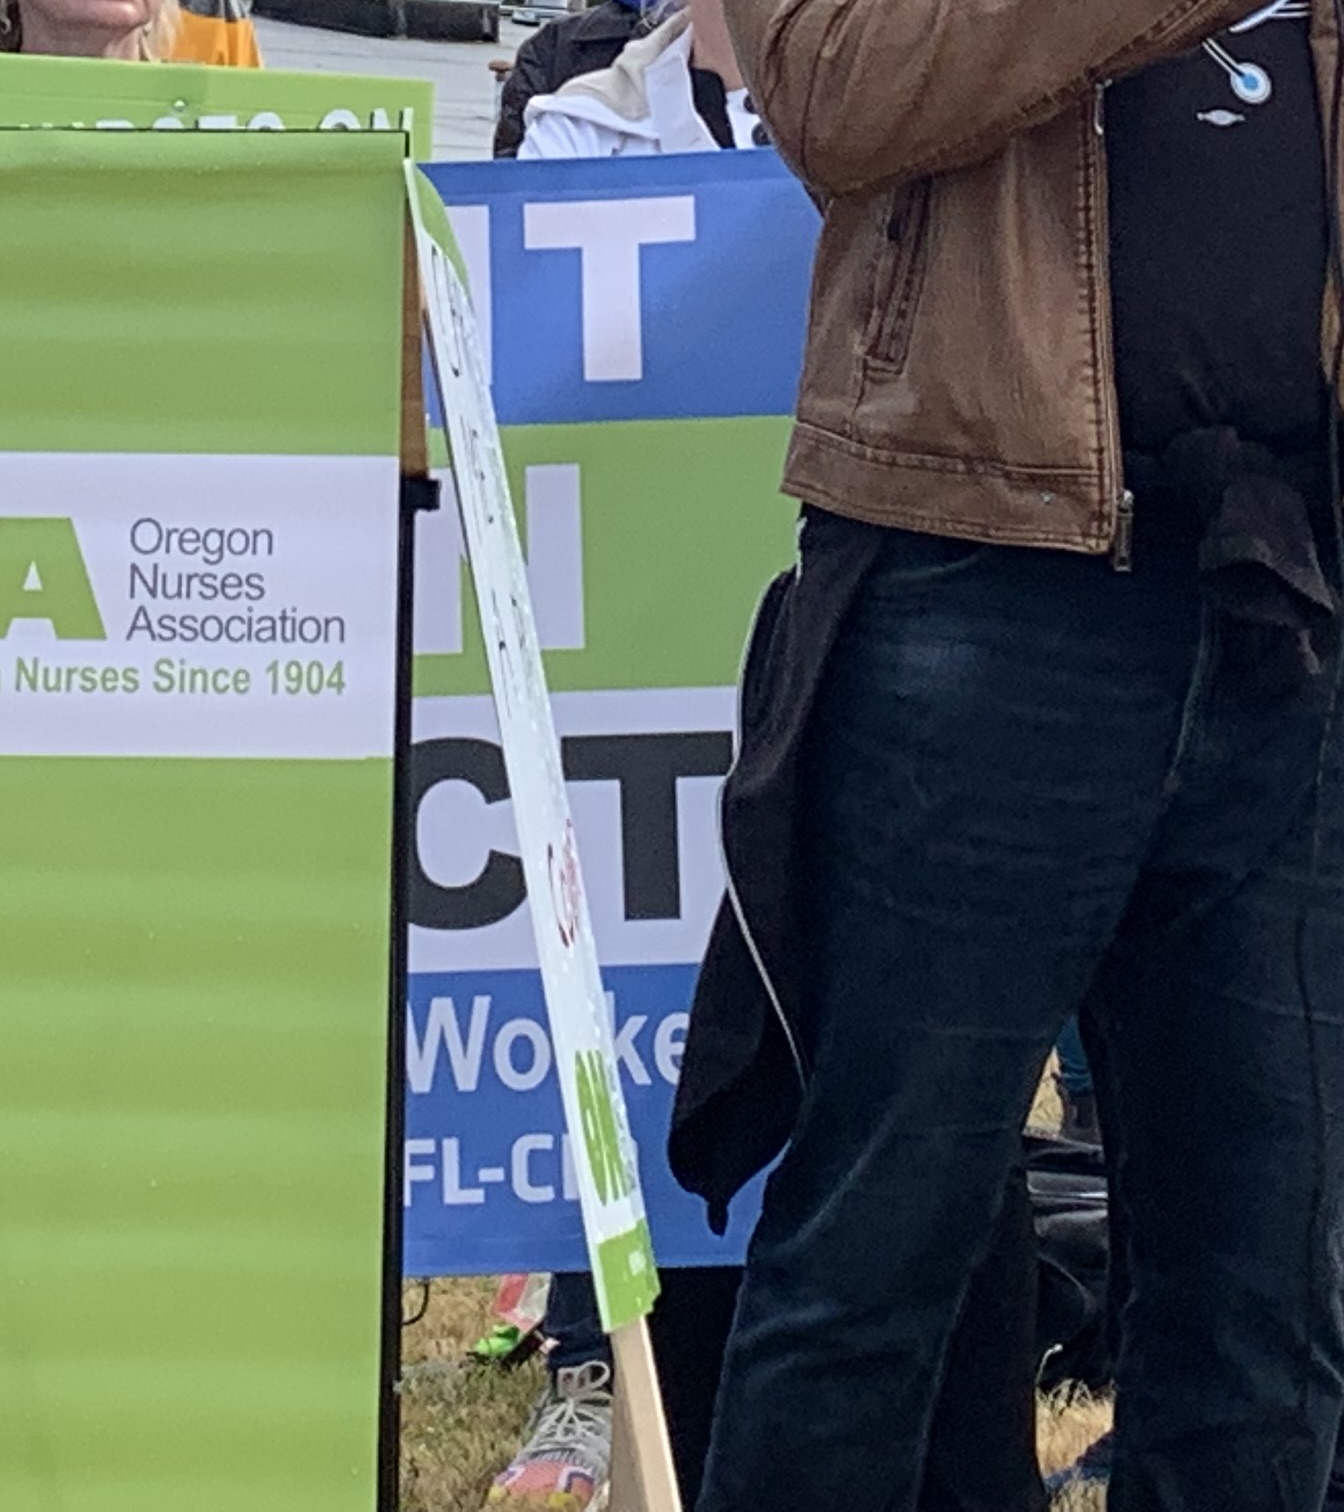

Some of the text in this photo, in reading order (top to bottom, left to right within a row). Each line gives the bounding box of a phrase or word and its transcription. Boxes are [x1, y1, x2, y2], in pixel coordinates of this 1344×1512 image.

[129, 517, 274, 566] Oregon
[129, 562, 266, 601] Nurses
[126, 604, 346, 643] Association
[15, 656, 140, 694] Nurses
[152, 657, 252, 695] Since
[265, 658, 346, 696] 1904
